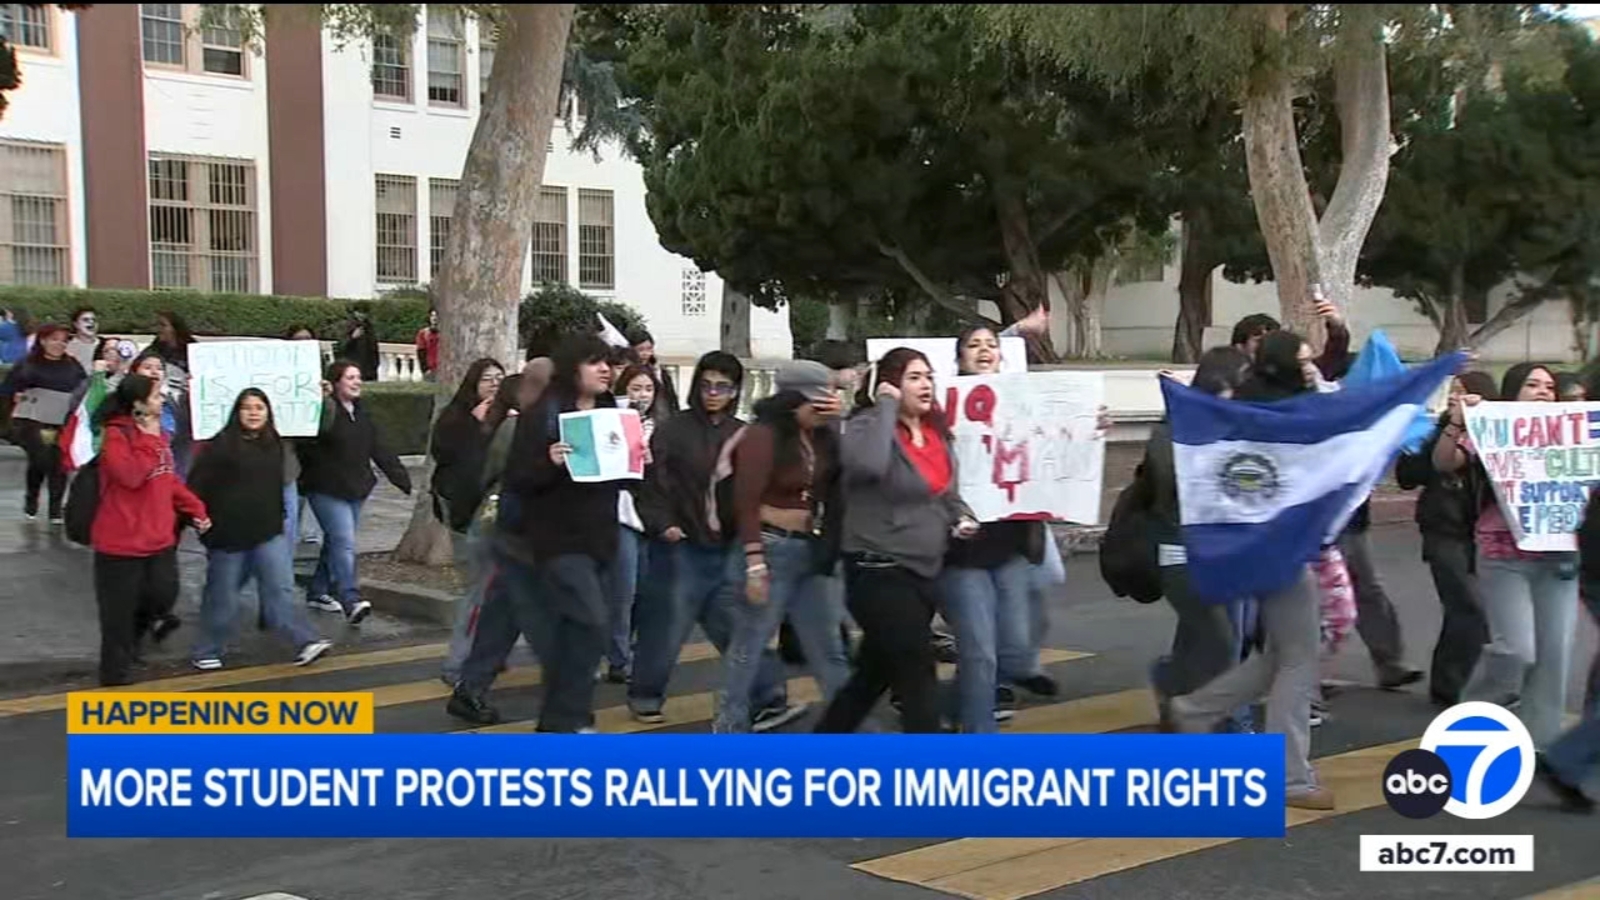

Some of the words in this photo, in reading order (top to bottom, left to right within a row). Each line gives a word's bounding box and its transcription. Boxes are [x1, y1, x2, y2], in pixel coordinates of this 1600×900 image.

[200, 374, 234, 399] IS
[250, 370, 321, 398] FOR
[1471, 416, 1508, 448] YOU
[1514, 409, 1584, 447] CAN'T
[1545, 446, 1600, 478] CULT
[1534, 503, 1581, 535] PEO
